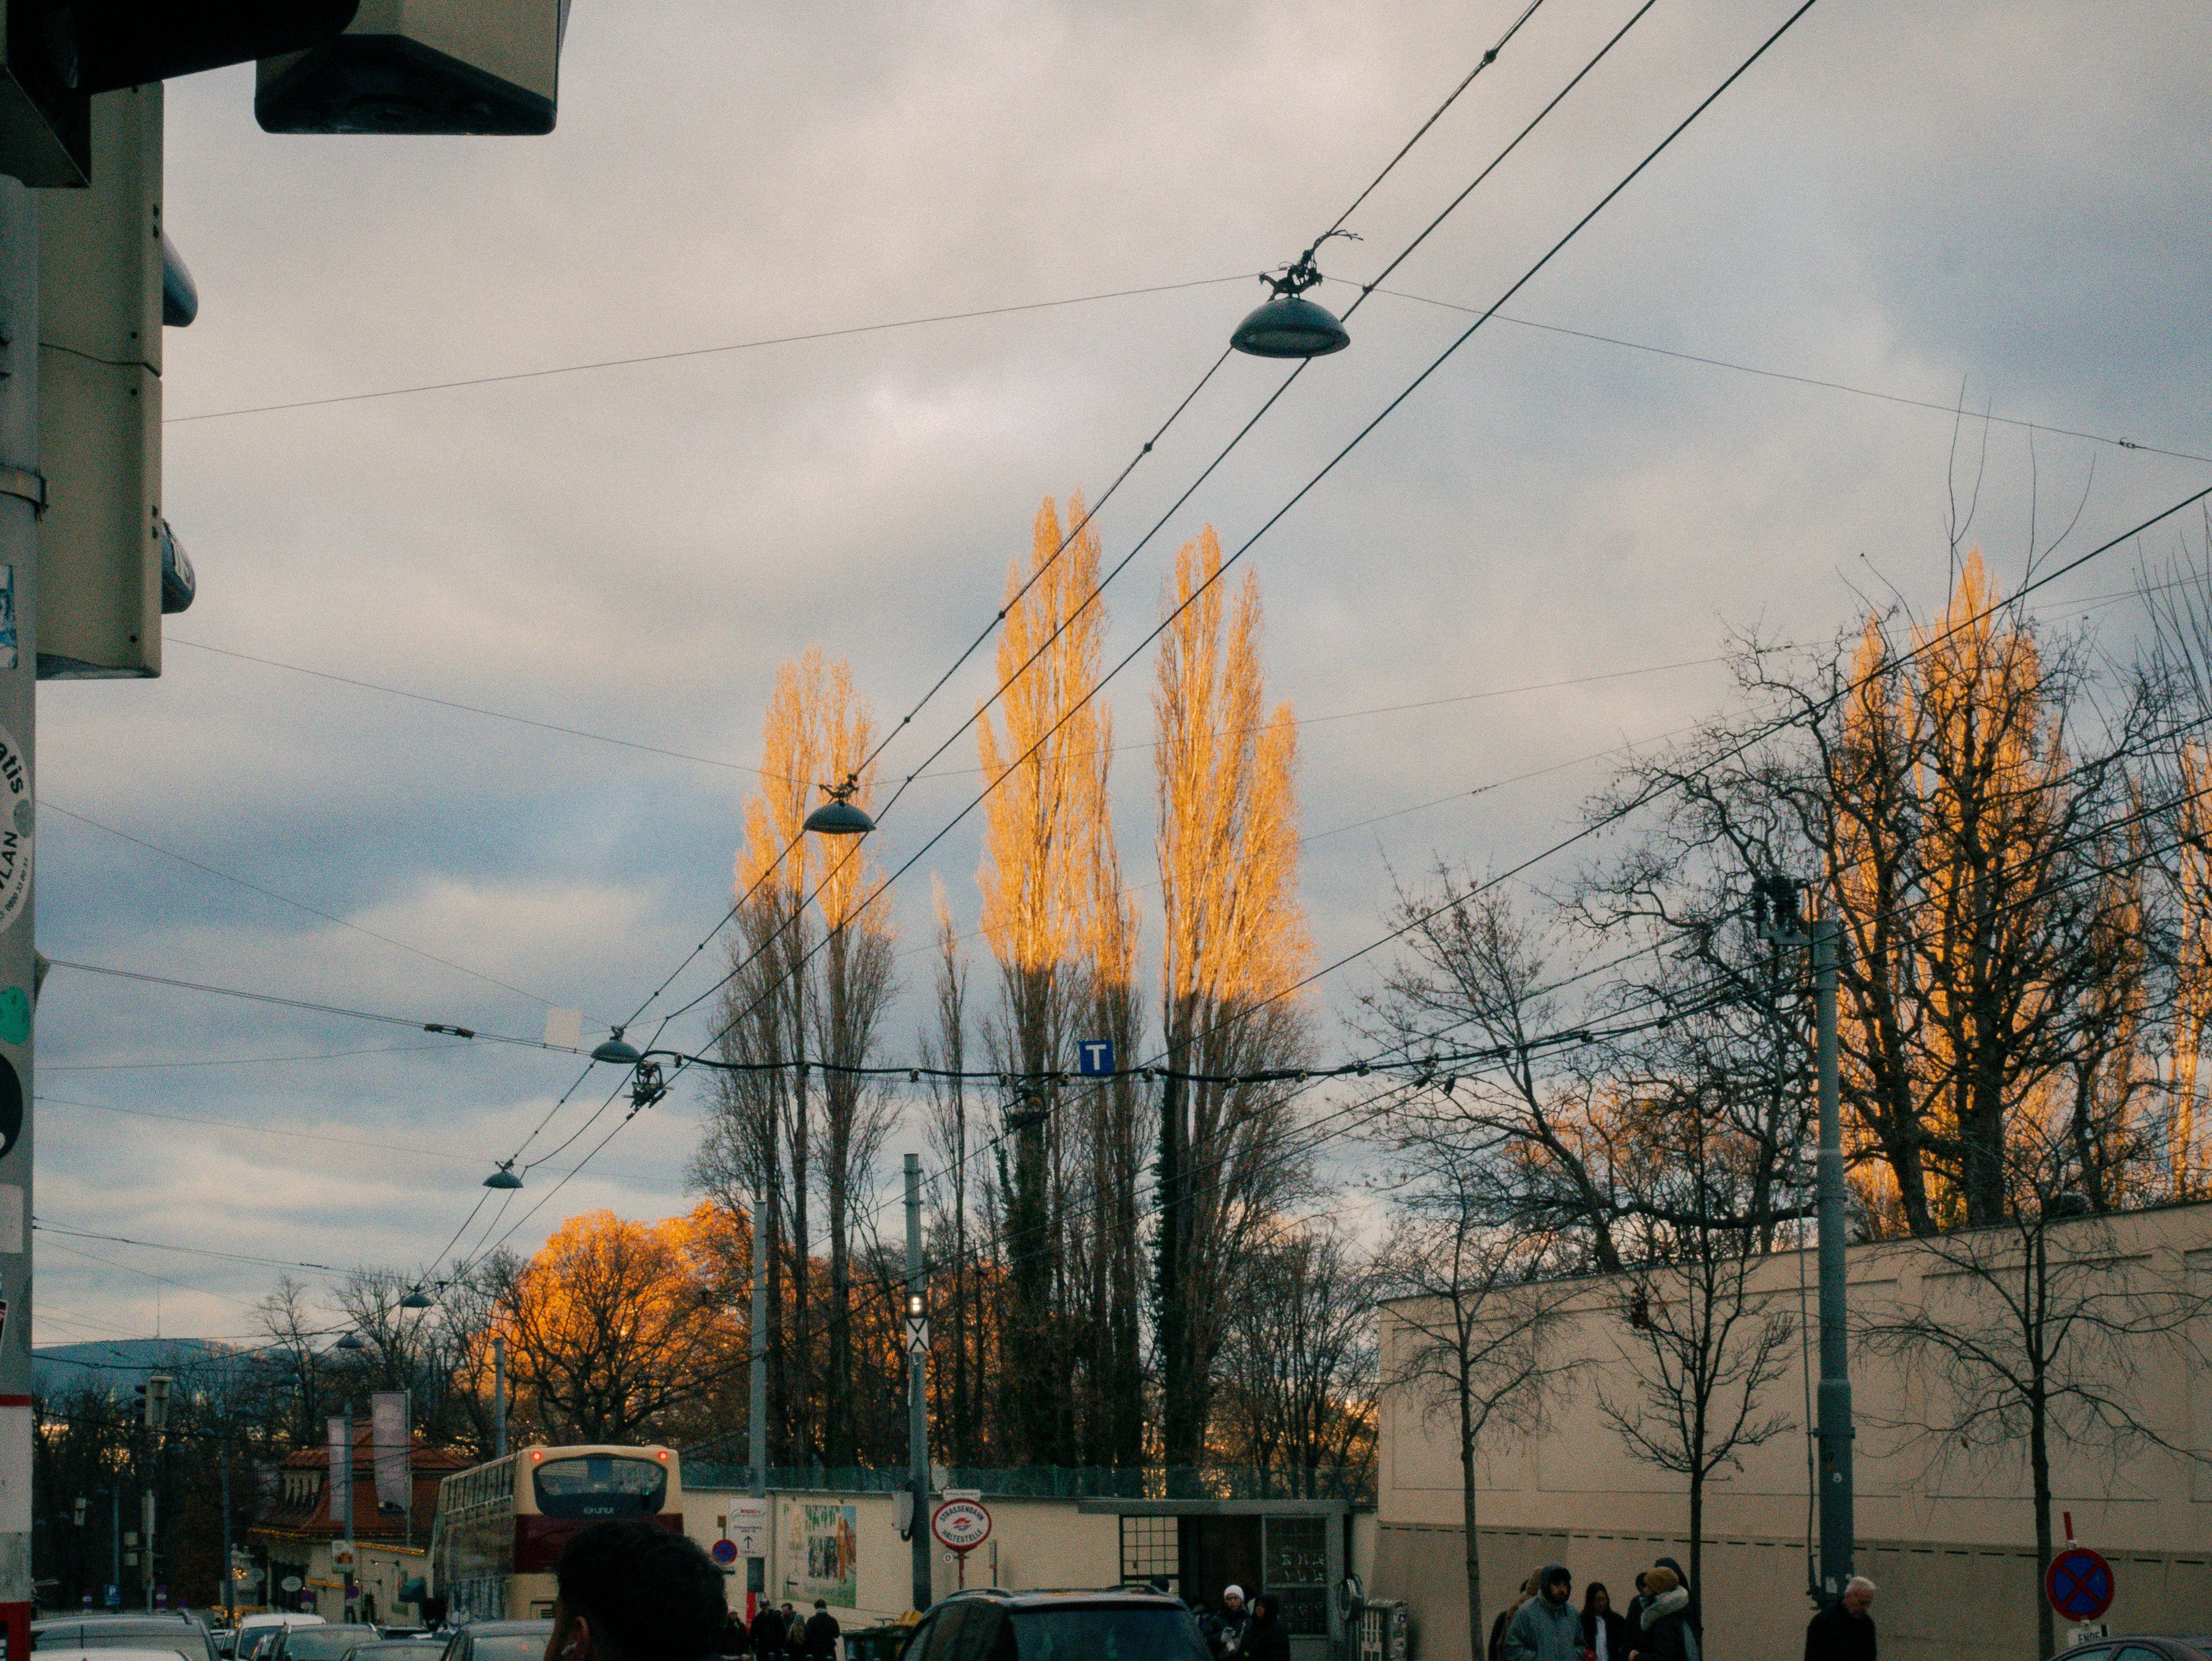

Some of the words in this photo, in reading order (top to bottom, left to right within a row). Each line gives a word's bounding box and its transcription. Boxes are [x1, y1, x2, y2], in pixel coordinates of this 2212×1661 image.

[0, 831, 17, 889] LAN
[1085, 1044, 1106, 1070] T
[940, 1505, 984, 1522] STRASSENBAHN
[943, 1529, 982, 1542] HALTESTELLE
[109, 1587, 116, 1596] P
